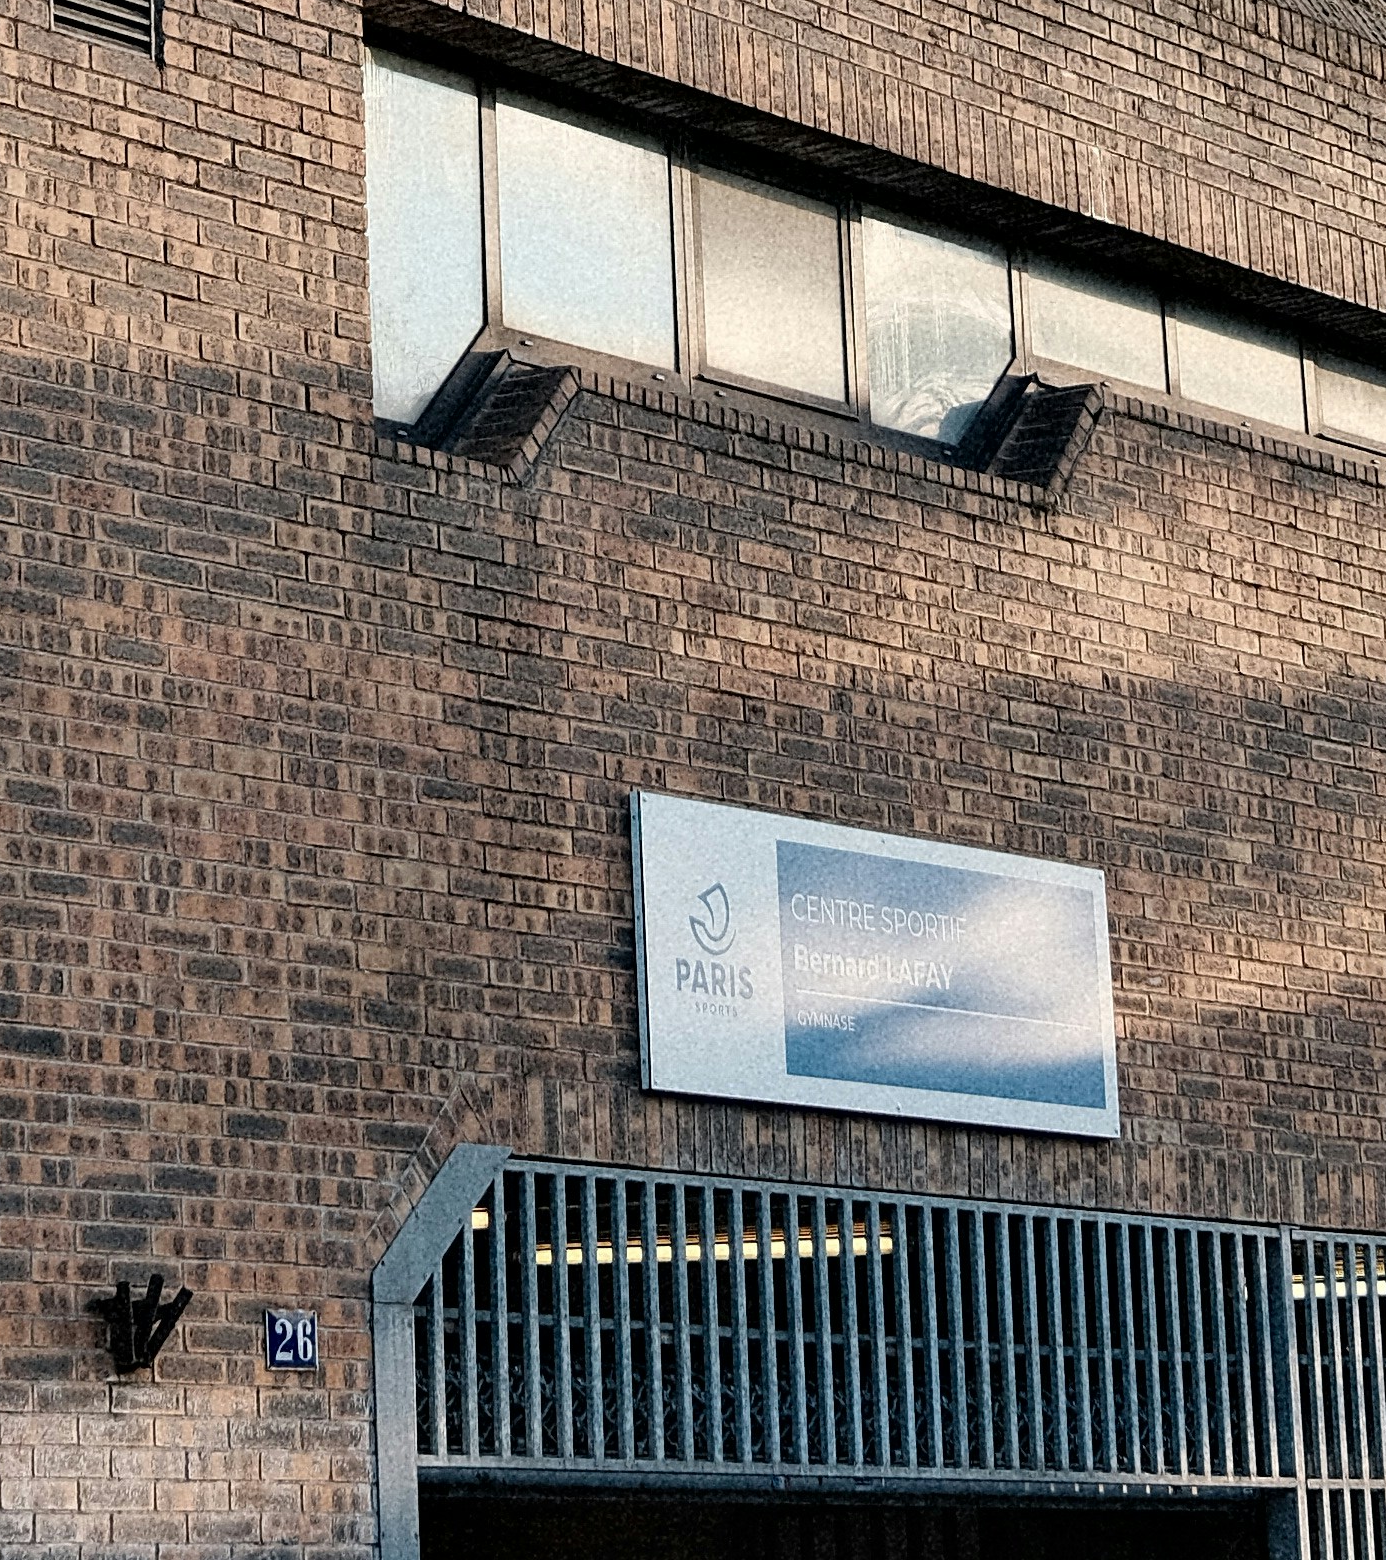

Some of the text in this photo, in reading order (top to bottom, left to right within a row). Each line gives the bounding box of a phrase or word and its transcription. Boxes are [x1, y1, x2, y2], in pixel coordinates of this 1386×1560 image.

[791, 893, 967, 943] CENTRE SPORTIF
[675, 957, 754, 1000] PARIS
[793, 943, 954, 990] Bernard LAFAY
[695, 1001, 738, 1017] SPORTS
[797, 1009, 856, 1031] GYMNASE
[274, 1318, 313, 1362] 26
